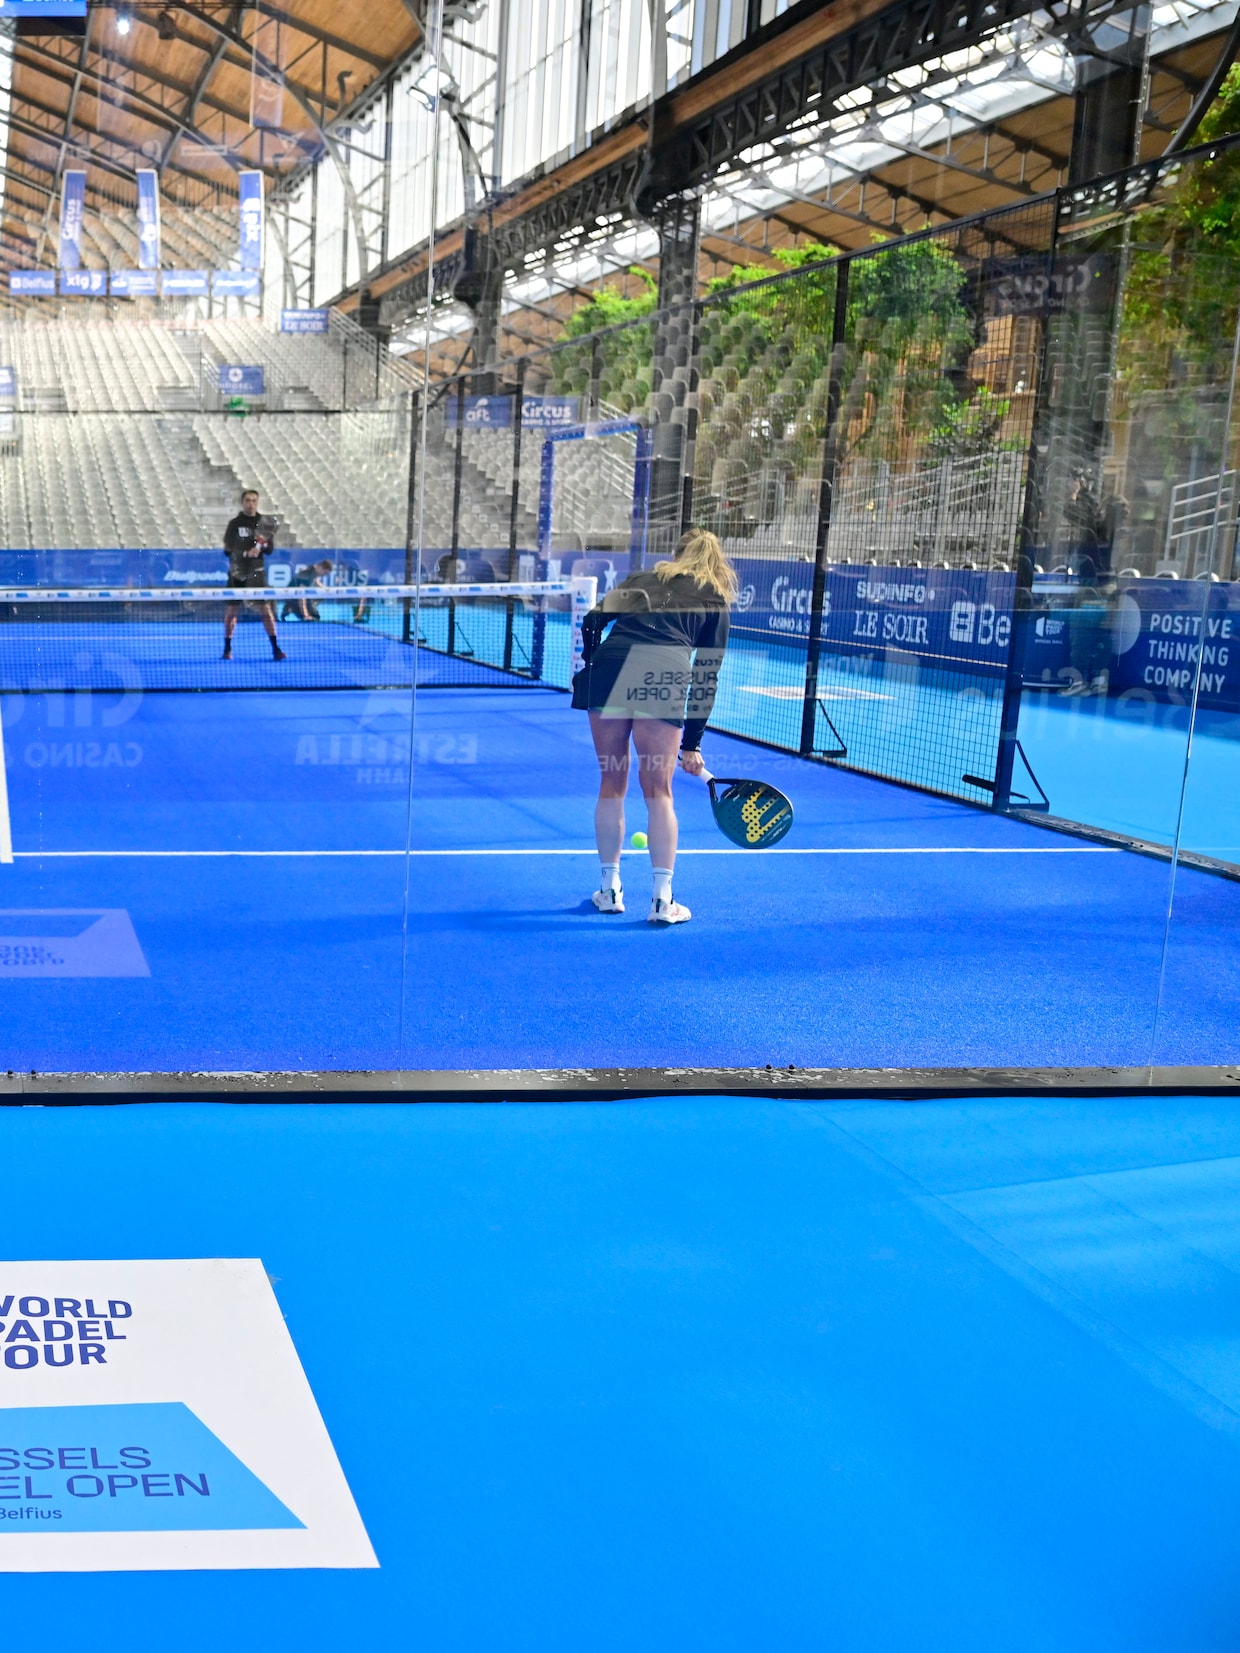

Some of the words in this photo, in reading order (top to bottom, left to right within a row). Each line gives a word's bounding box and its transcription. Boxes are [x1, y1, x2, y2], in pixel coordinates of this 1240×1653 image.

[21, 274, 55, 289] Belfius
[521, 401, 572, 418] Circus
[853, 610, 878, 639] LE
[882, 613, 929, 645] SOIR
[66, 1472, 211, 1498] OPEN
